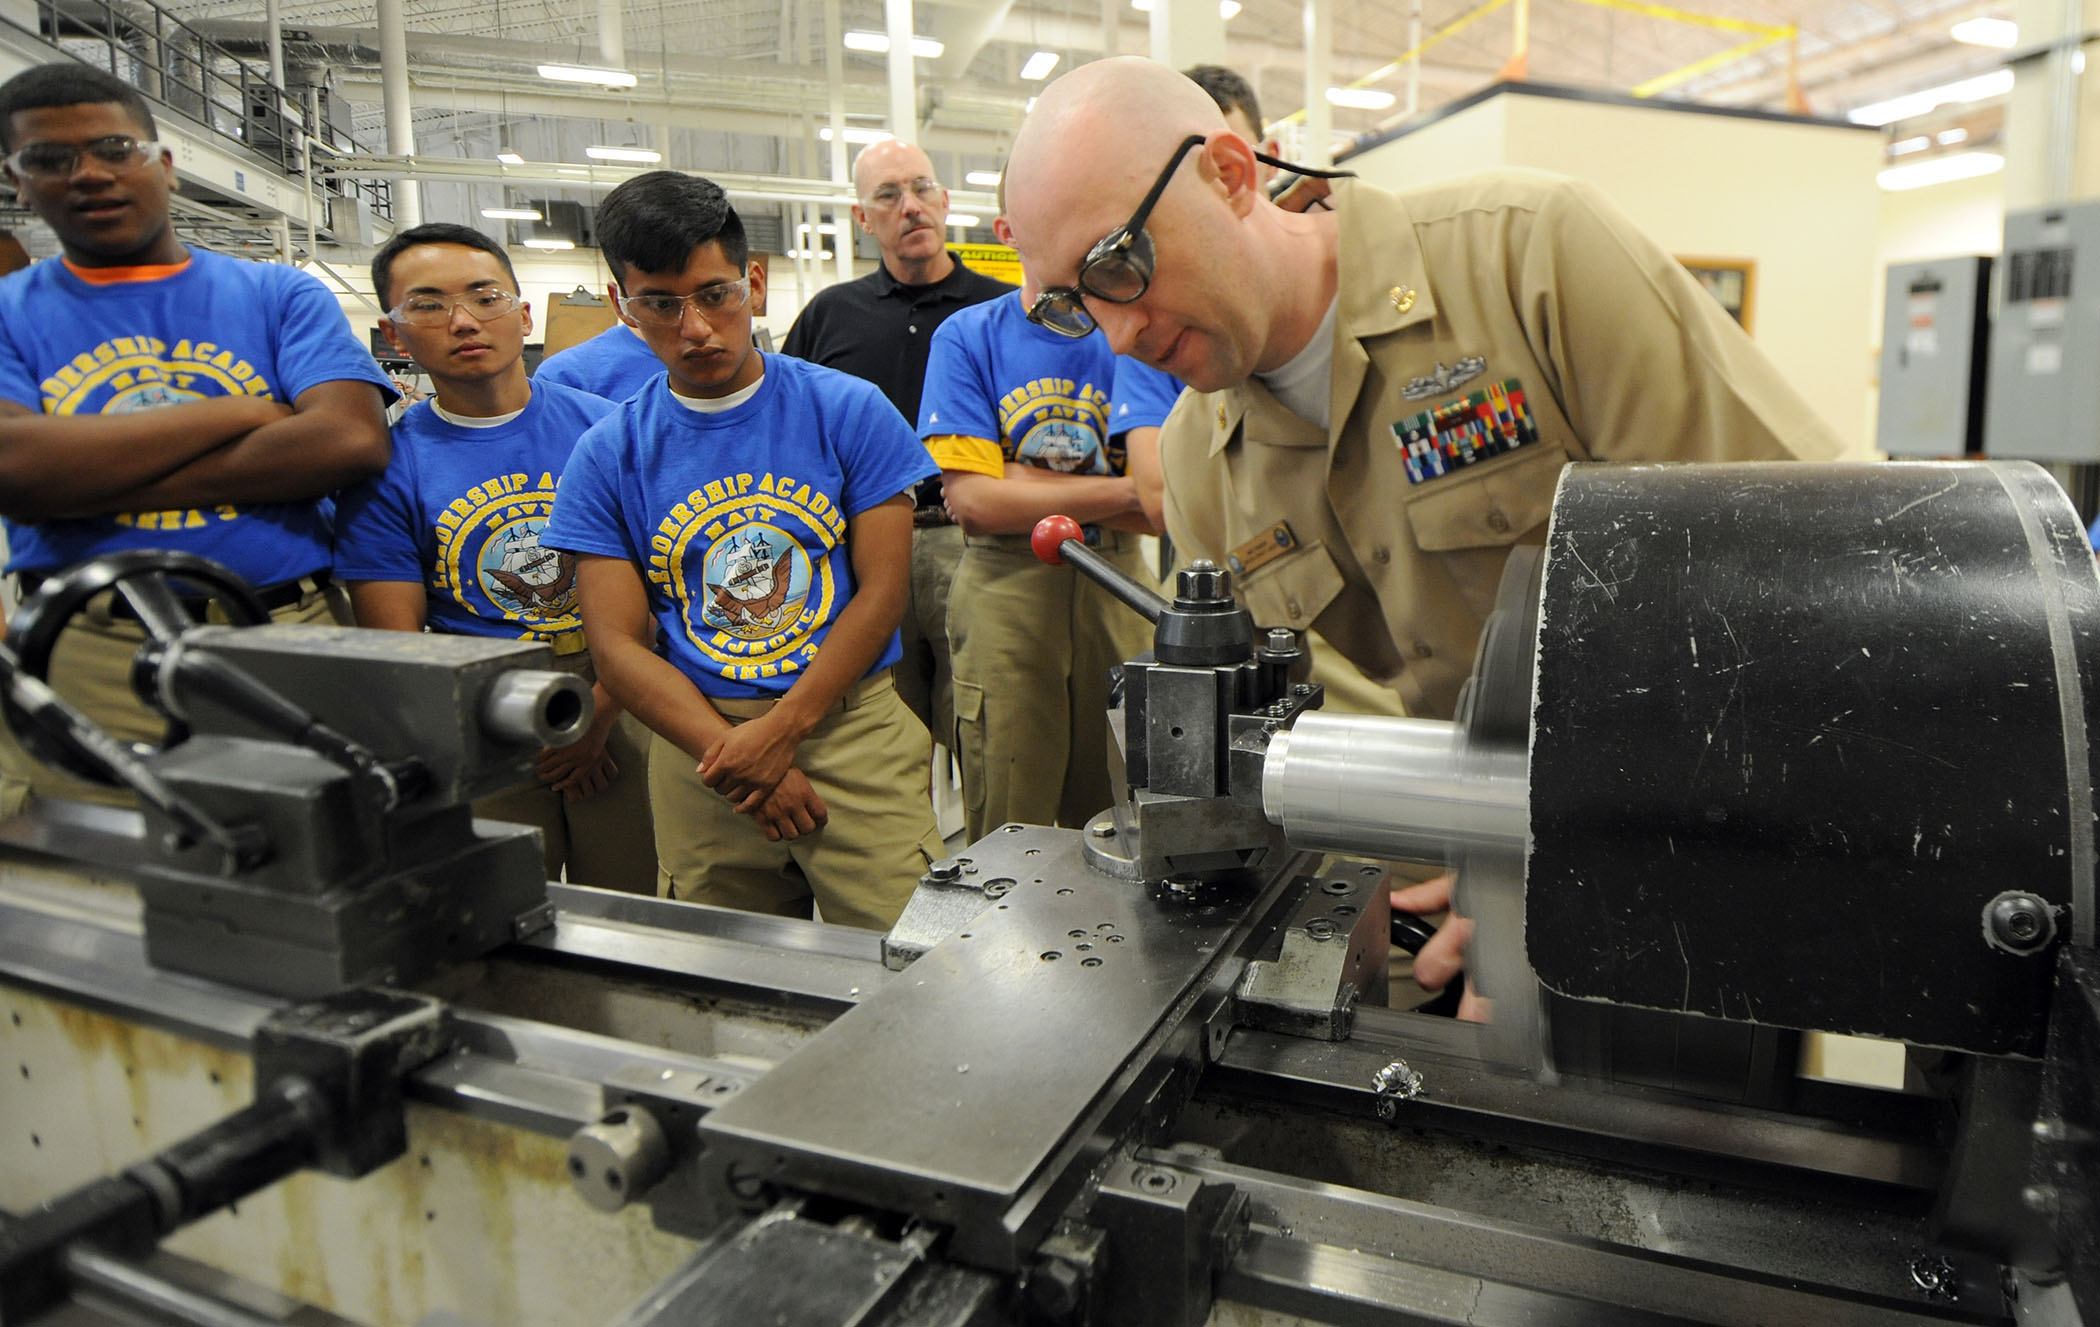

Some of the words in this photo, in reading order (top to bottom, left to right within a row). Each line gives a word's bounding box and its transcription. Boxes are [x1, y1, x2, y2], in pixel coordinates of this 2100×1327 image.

[961, 250, 1019, 261] AUTION
[1034, 406, 1091, 422] NAVY
[434, 473, 529, 588] LEADERSHIP
[704, 506, 777, 540] NAVY
[710, 608, 815, 654] NJROTC
[720, 659, 799, 680] AREA
[800, 642, 819, 661] 3
